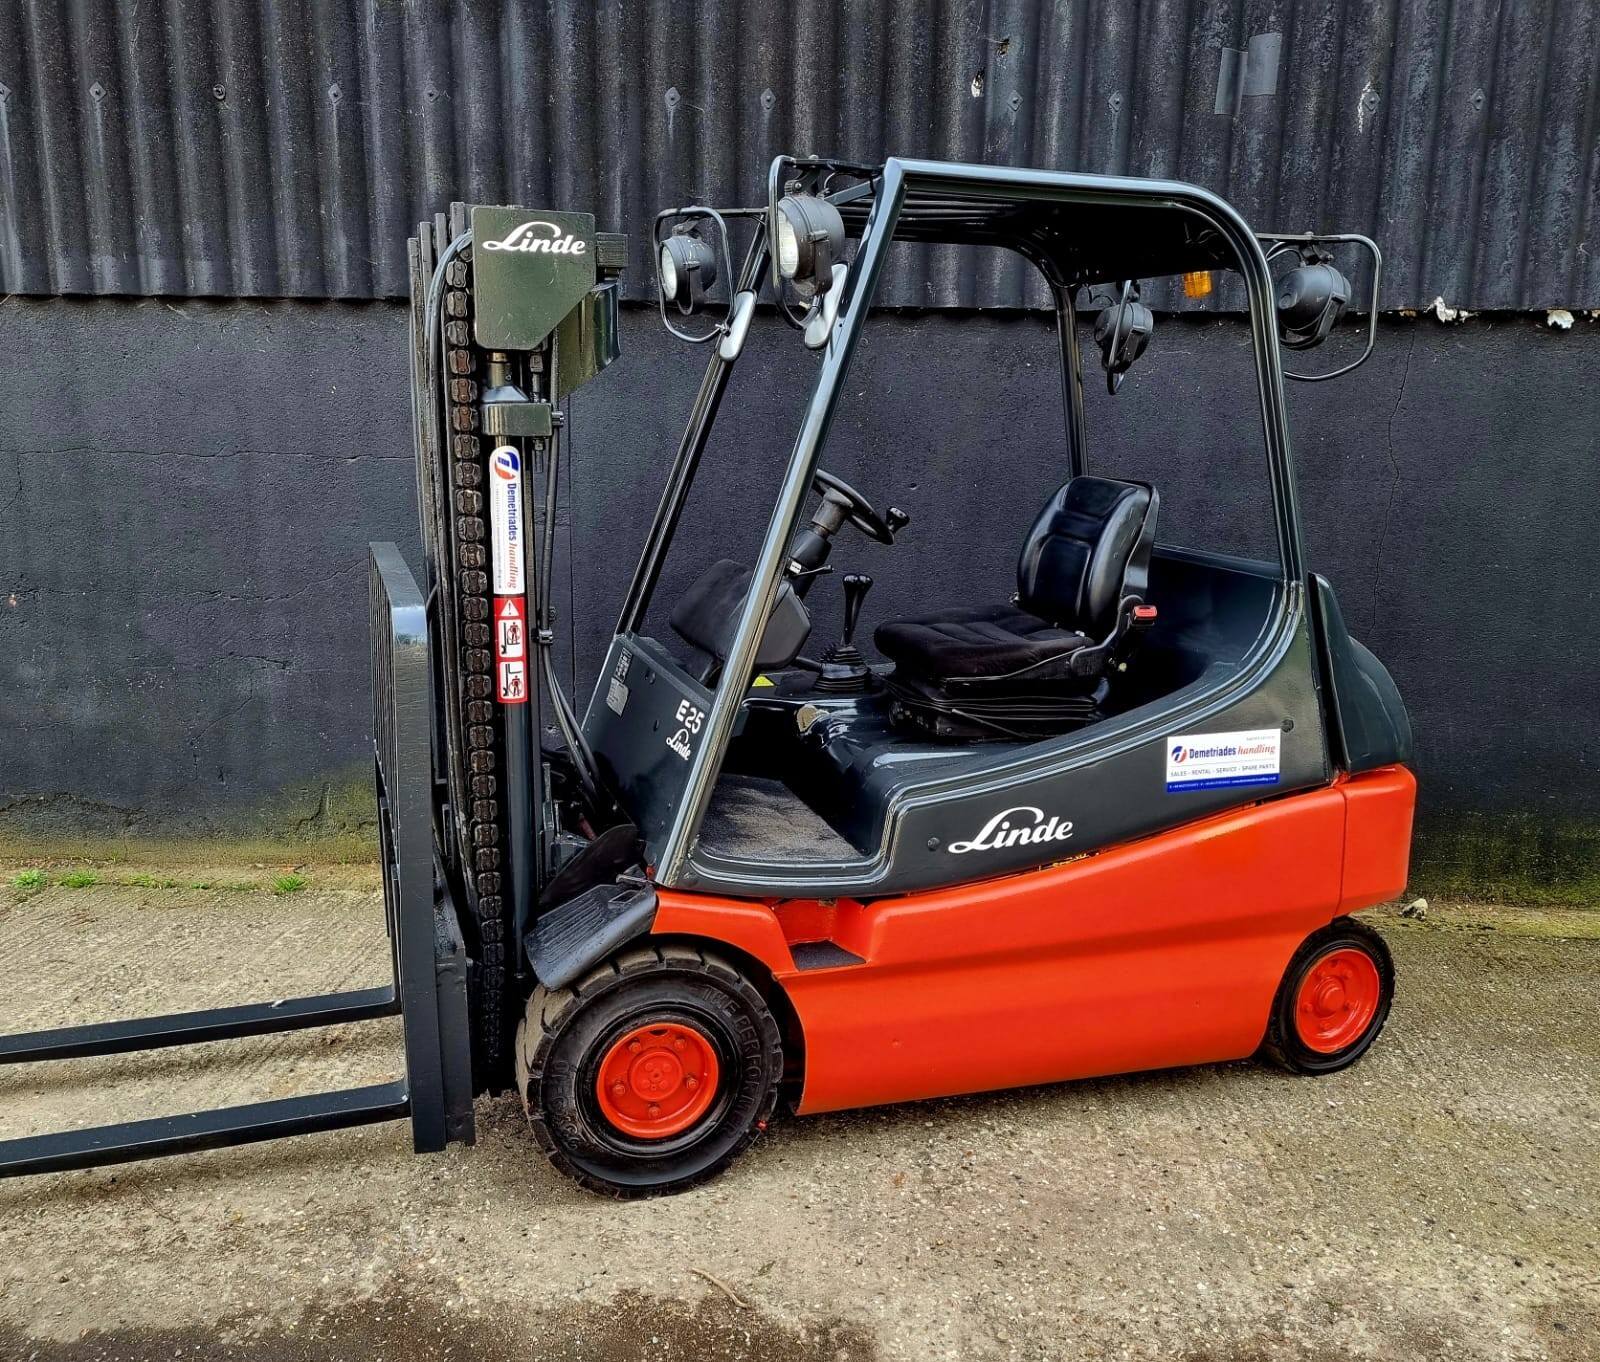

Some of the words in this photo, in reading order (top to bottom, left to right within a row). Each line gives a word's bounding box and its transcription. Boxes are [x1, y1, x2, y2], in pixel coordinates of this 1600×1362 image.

[482, 221, 586, 255] Linde
[506, 483, 518, 541] Demetriades
[507, 543, 519, 588] handling
[666, 728, 693, 761] Linde
[1189, 746, 1237, 759] Demetriades
[1238, 744, 1276, 756] handling
[1170, 769, 1187, 777] SALES
[1191, 768, 1212, 776] RENTAL
[1216, 766, 1237, 774] SERVICE
[1242, 764, 1258, 772] SPARE
[947, 806, 1073, 854] Linde
